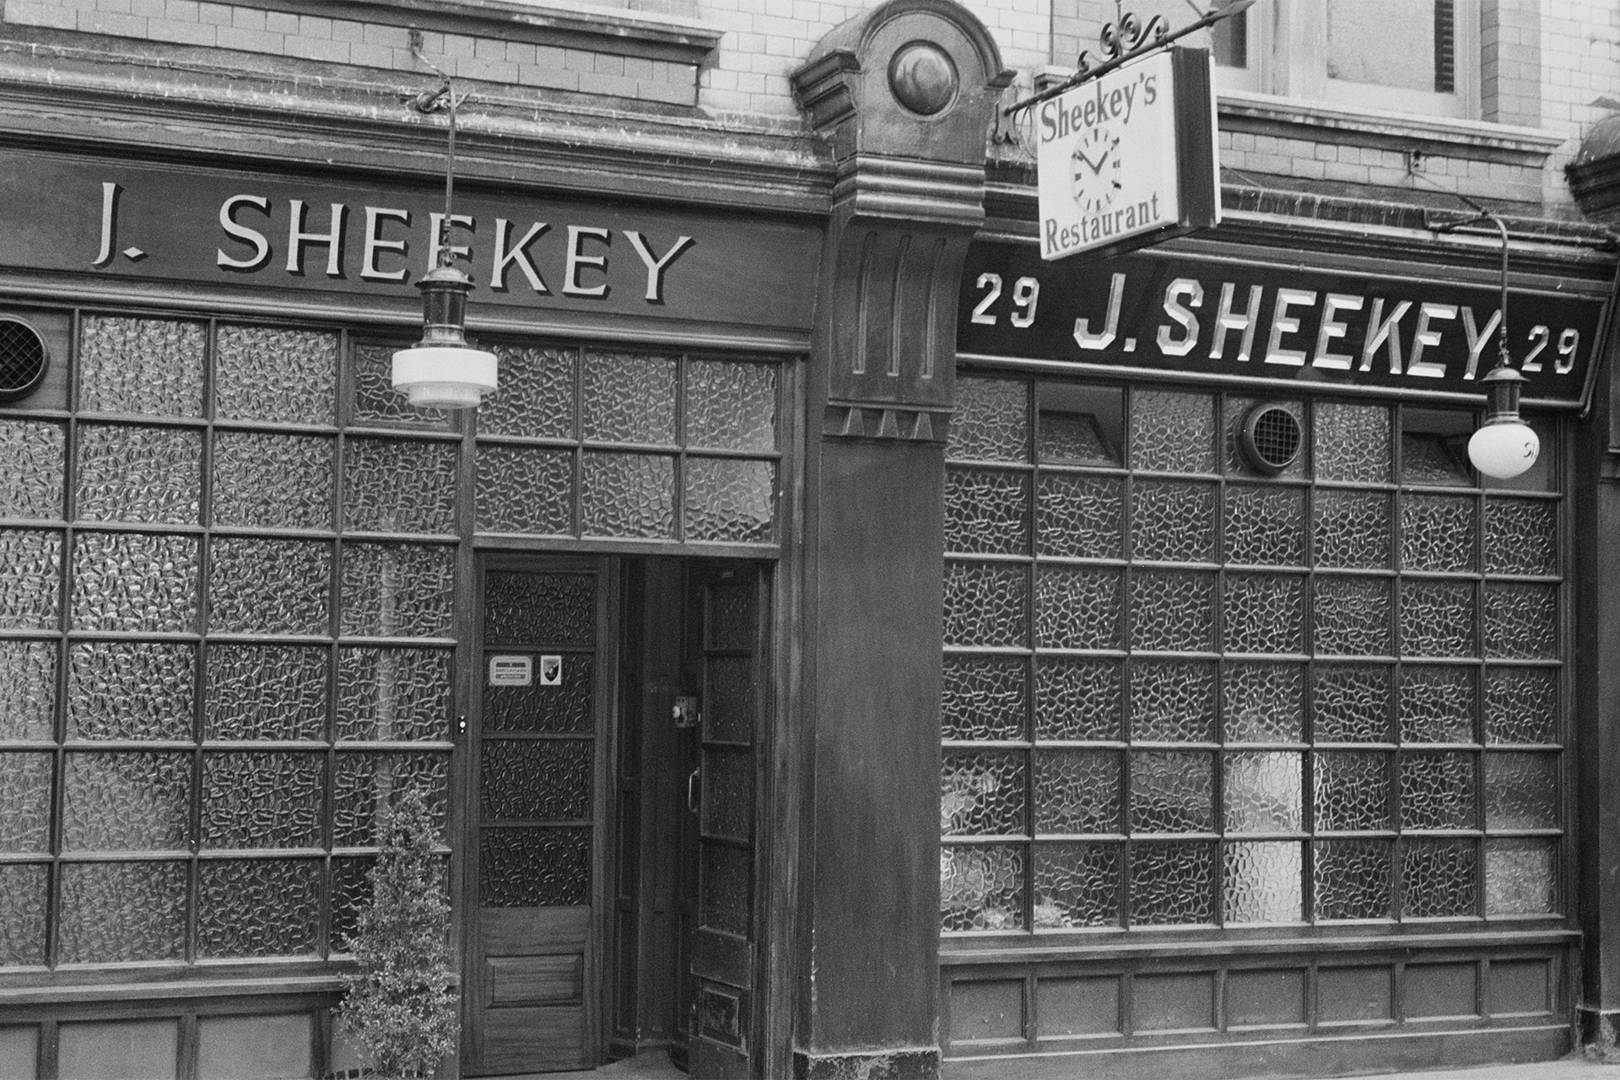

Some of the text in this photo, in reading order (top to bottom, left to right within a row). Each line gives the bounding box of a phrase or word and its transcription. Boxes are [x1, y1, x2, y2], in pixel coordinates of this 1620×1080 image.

[1041, 72, 1157, 144] Sheekey's
[92, 182, 693, 301] J. SHEEKEY
[1045, 192, 1160, 254] Restaurant
[971, 272, 1580, 381] 29 J. SHEEKEY 29
